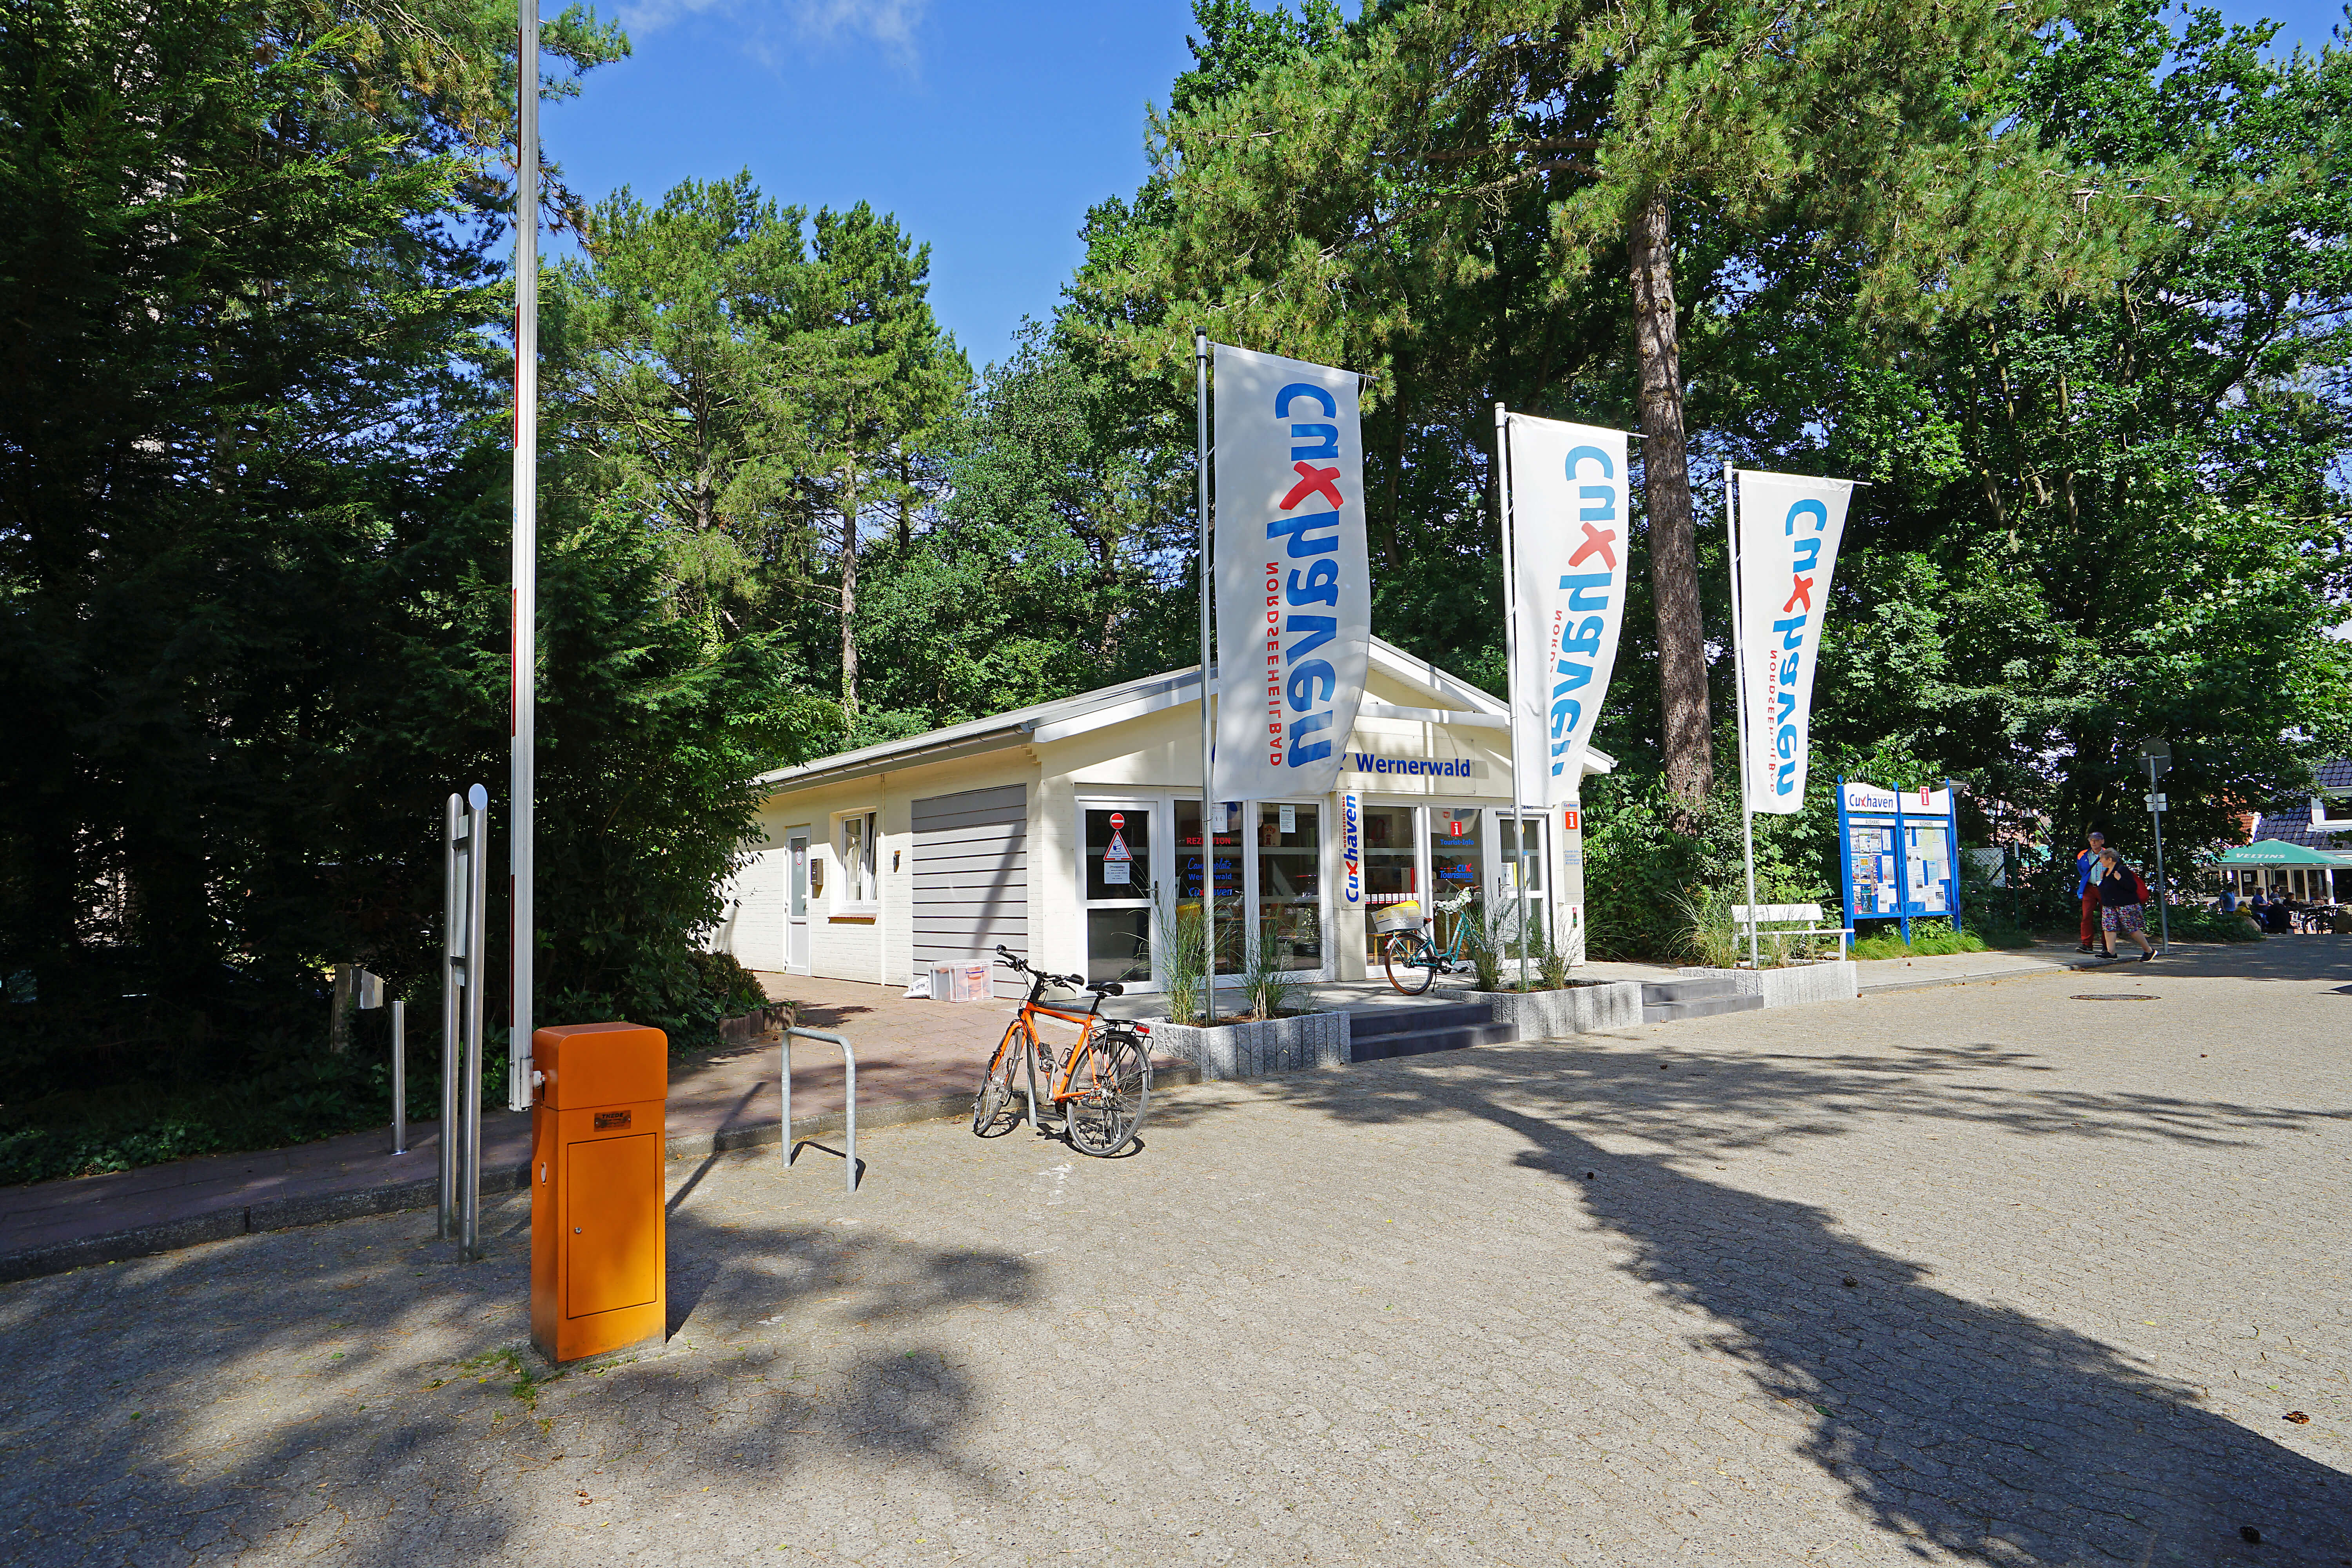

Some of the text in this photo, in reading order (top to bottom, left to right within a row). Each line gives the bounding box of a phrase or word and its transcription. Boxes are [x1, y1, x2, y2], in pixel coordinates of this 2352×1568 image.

[1355, 753, 1470, 777] Wernerwald
[1849, 793, 1893, 808] Cuxhaven
[1344, 795, 1359, 902] Cuxhaven
[1439, 870, 1474, 878] Tourismus
